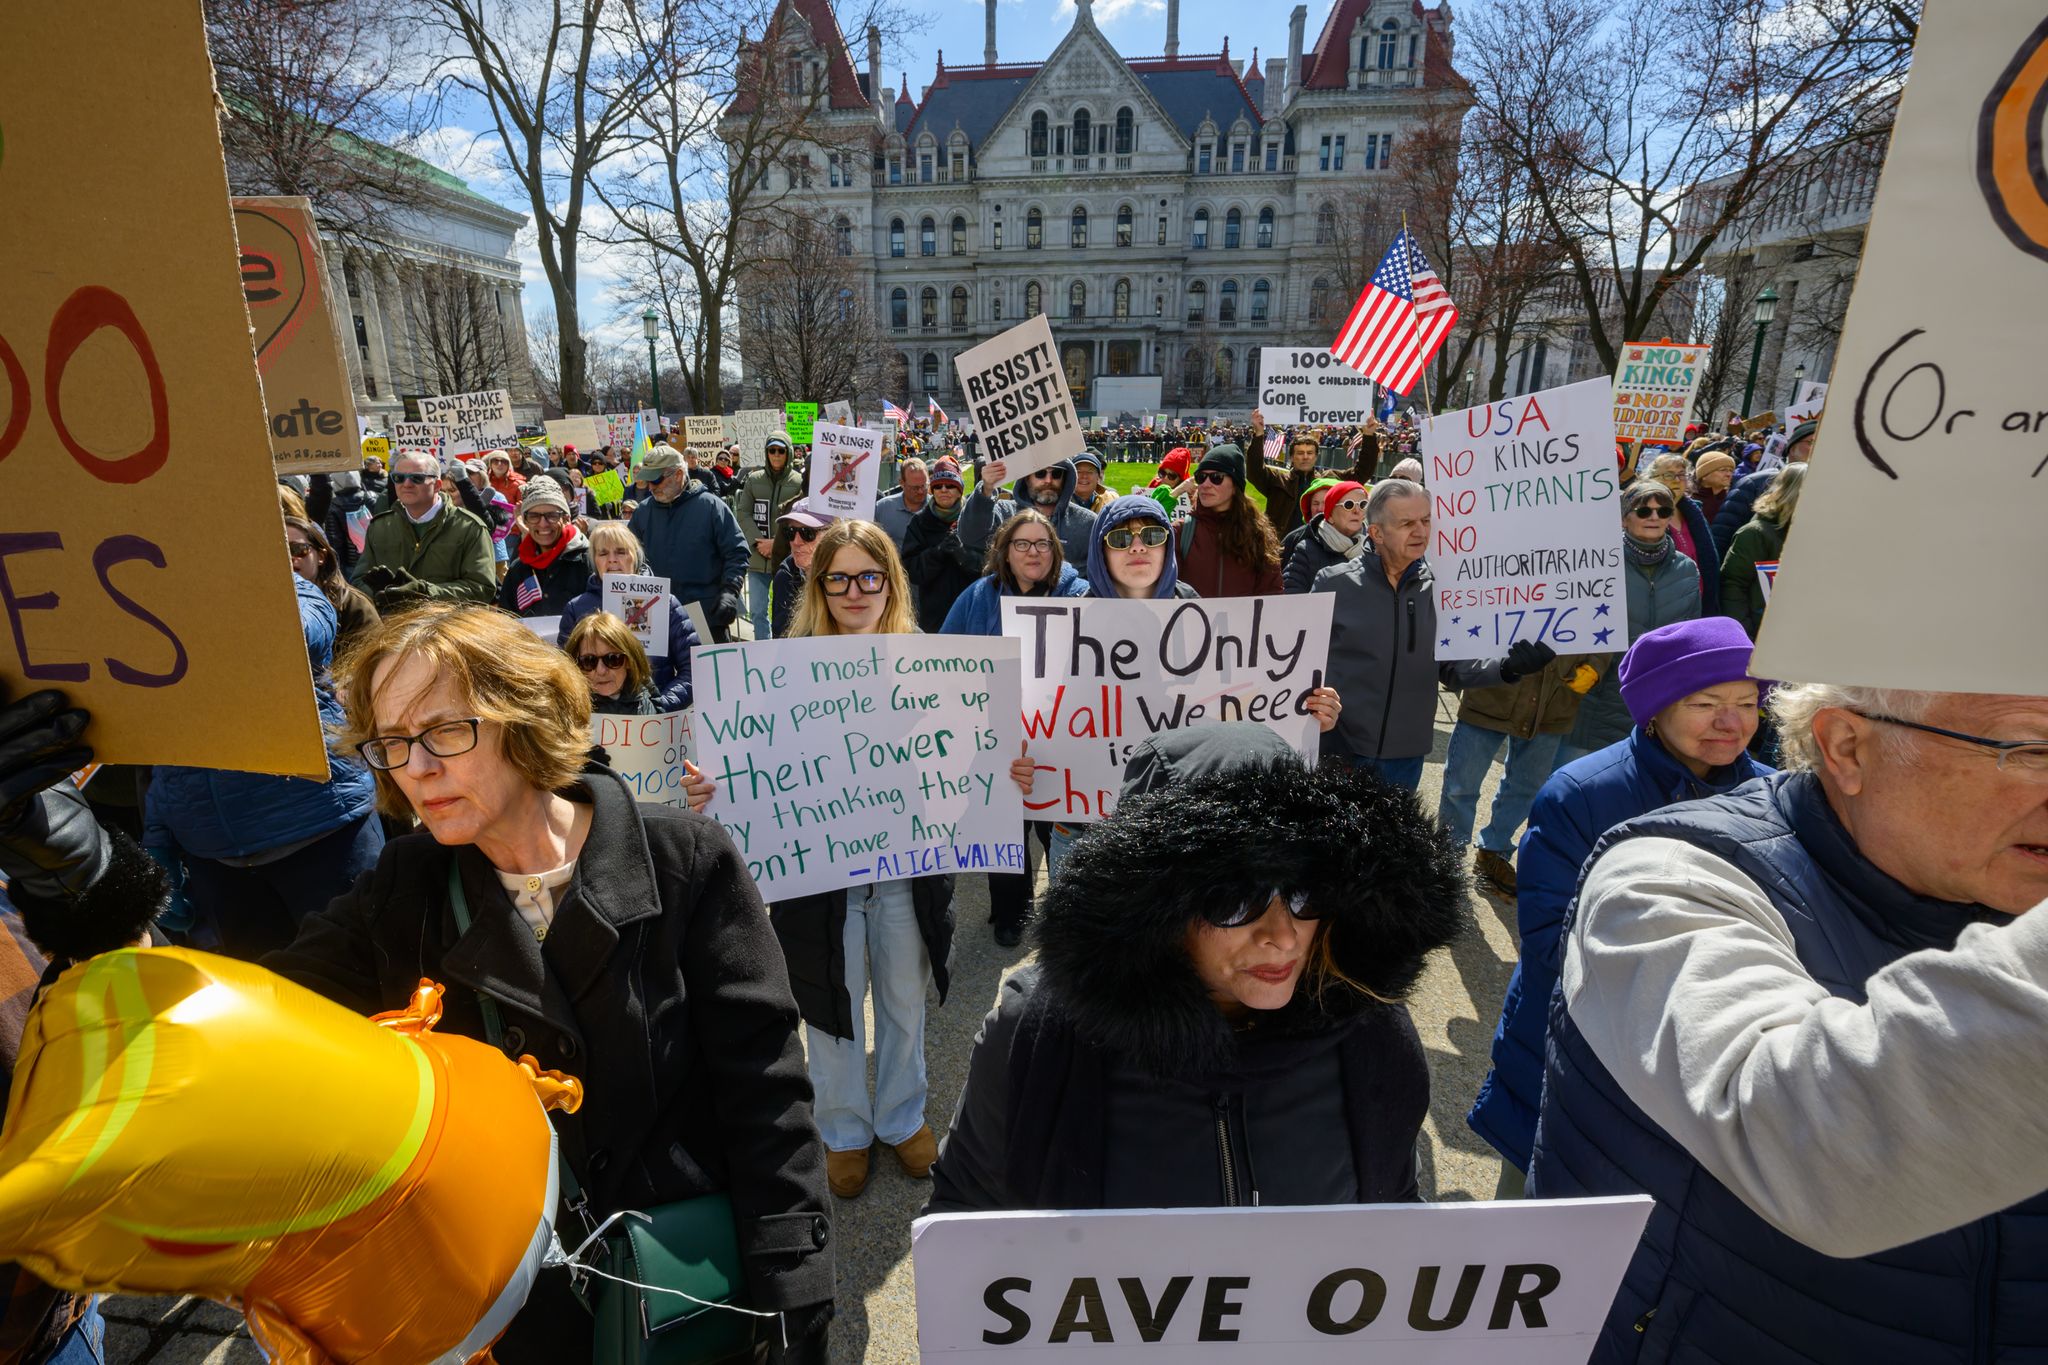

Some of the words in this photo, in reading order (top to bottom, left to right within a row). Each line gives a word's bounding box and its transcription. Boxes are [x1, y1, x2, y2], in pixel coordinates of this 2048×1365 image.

[1644, 348, 1682, 364] NO
[0, 285, 169, 485] O
[967, 341, 1053, 403] RESIST!
[1268, 375, 1310, 385] SCHOOL
[1318, 376, 1370, 386] CHILDREN
[1622, 365, 1695, 386] KINGS
[467, 392, 502, 408] MAKE
[976, 372, 1062, 432] RESIST!
[1262, 389, 1306, 405] Gone
[1632, 393, 1668, 408] NO
[268, 399, 343, 437] ate
[457, 408, 504, 424] REPEAT
[608, 424, 632, 432] Nevr
[688, 419, 718, 427] IMPEACH
[736, 411, 777, 424] REGIME
[1300, 405, 1364, 423] Forever
[1467, 396, 1550, 438] USA
[1613, 408, 1683, 425] IDIOTS
[397, 438, 431, 447] MAKES
[433, 437, 446, 446] US
[690, 427, 721, 435] TRUMP!
[822, 432, 836, 443] NO
[839, 435, 874, 450] KINGS!
[985, 402, 1072, 462] RESIST!
[1434, 450, 1474, 481] NO
[1436, 490, 1476, 519] NO
[1484, 468, 1613, 512] TYRANTS
[1438, 526, 1477, 556] NO
[611, 582, 627, 591] NO
[629, 583, 663, 594] KINGS!
[1016, 606, 1140, 680] The
[1159, 598, 1307, 682] Only
[1494, 607, 1578, 646] 1776
[697, 647, 786, 702] The
[811, 647, 885, 683] most
[702, 700, 775, 747] Way
[790, 690, 876, 733] people
[891, 684, 940, 711] Give
[961, 691, 990, 712] up
[1021, 685, 1122, 740] Wall
[1137, 694, 1206, 732] We
[664, 745, 688, 765] OR
[715, 752, 831, 804] their
[844, 729, 954, 774] Power
[975, 726, 998, 751] is
[918, 771, 994, 806] they
[826, 831, 889, 864] have
[954, 843, 1024, 869] WALKER
[982, 1276, 1251, 1345] SAVE
[1306, 1263, 1561, 1336] OUR
